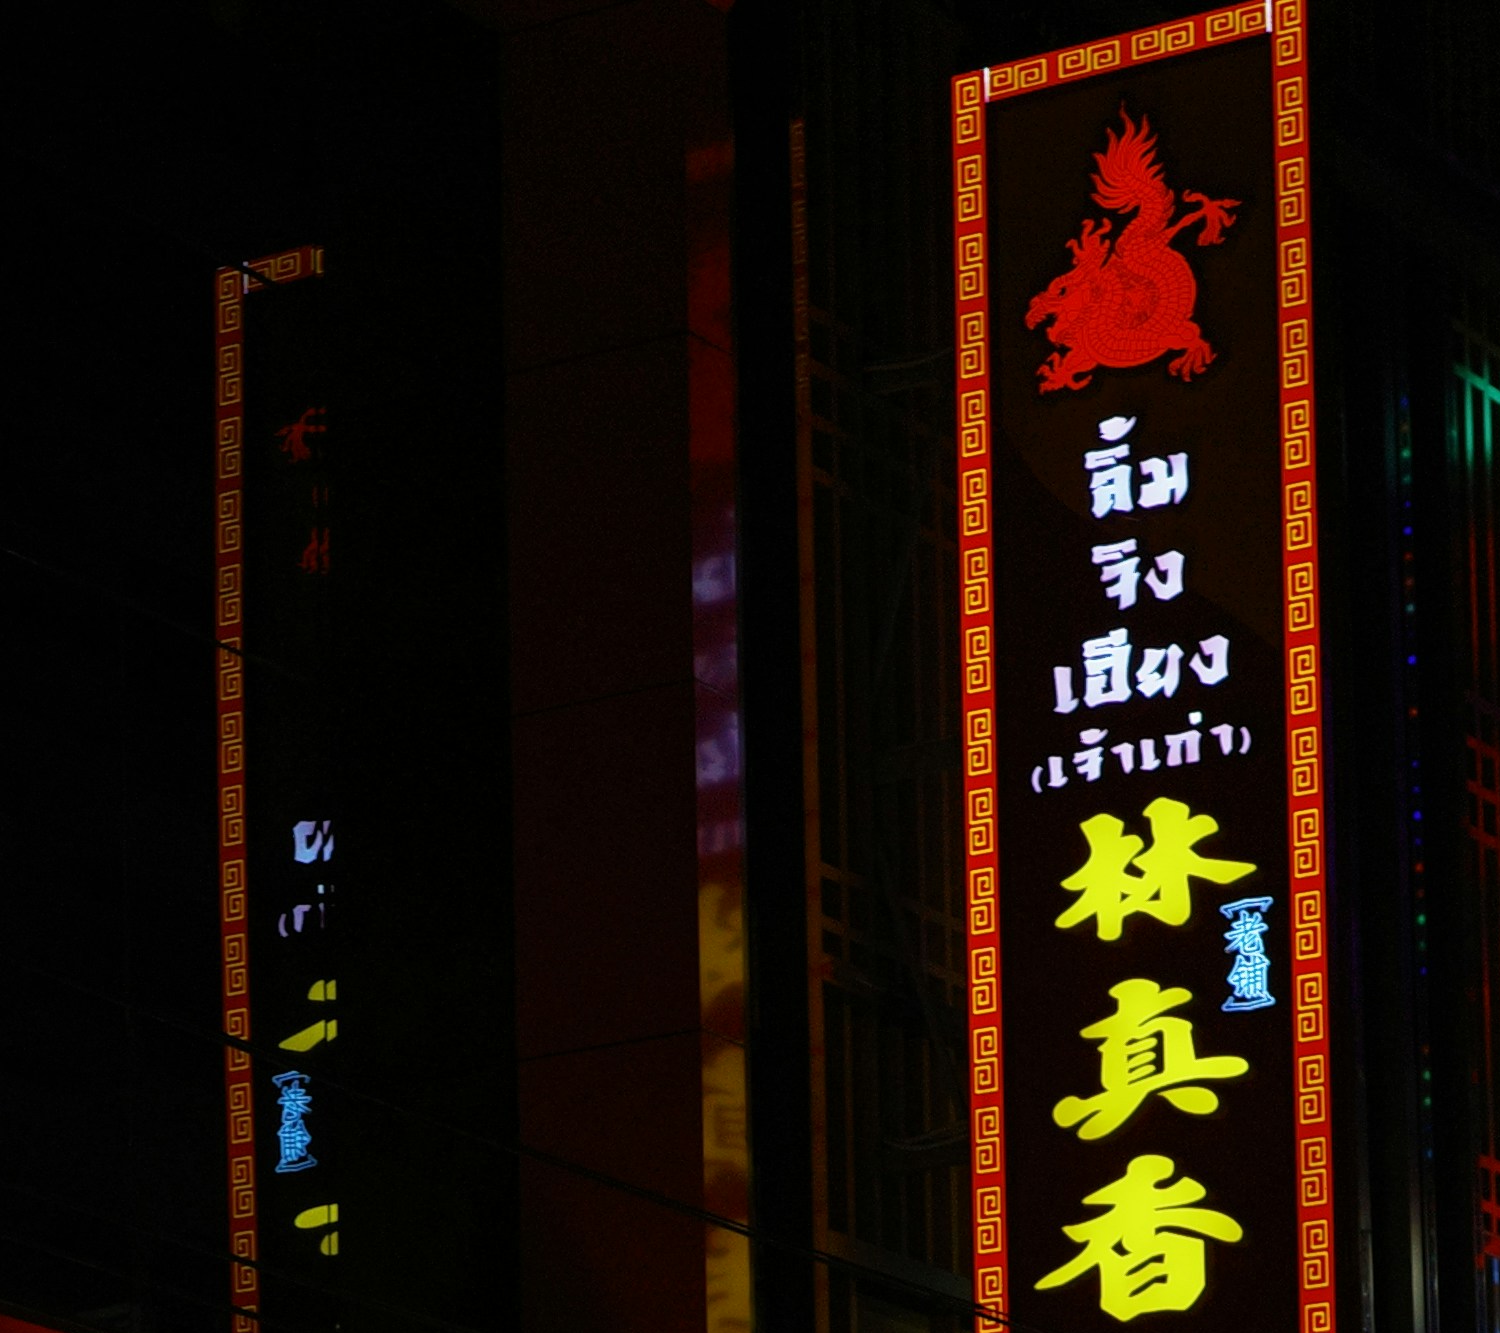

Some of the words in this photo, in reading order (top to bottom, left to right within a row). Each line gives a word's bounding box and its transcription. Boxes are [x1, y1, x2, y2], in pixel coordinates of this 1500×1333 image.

[1092, 537, 1186, 610] จิง
[1035, 797, 1257, 1322] 林真香
